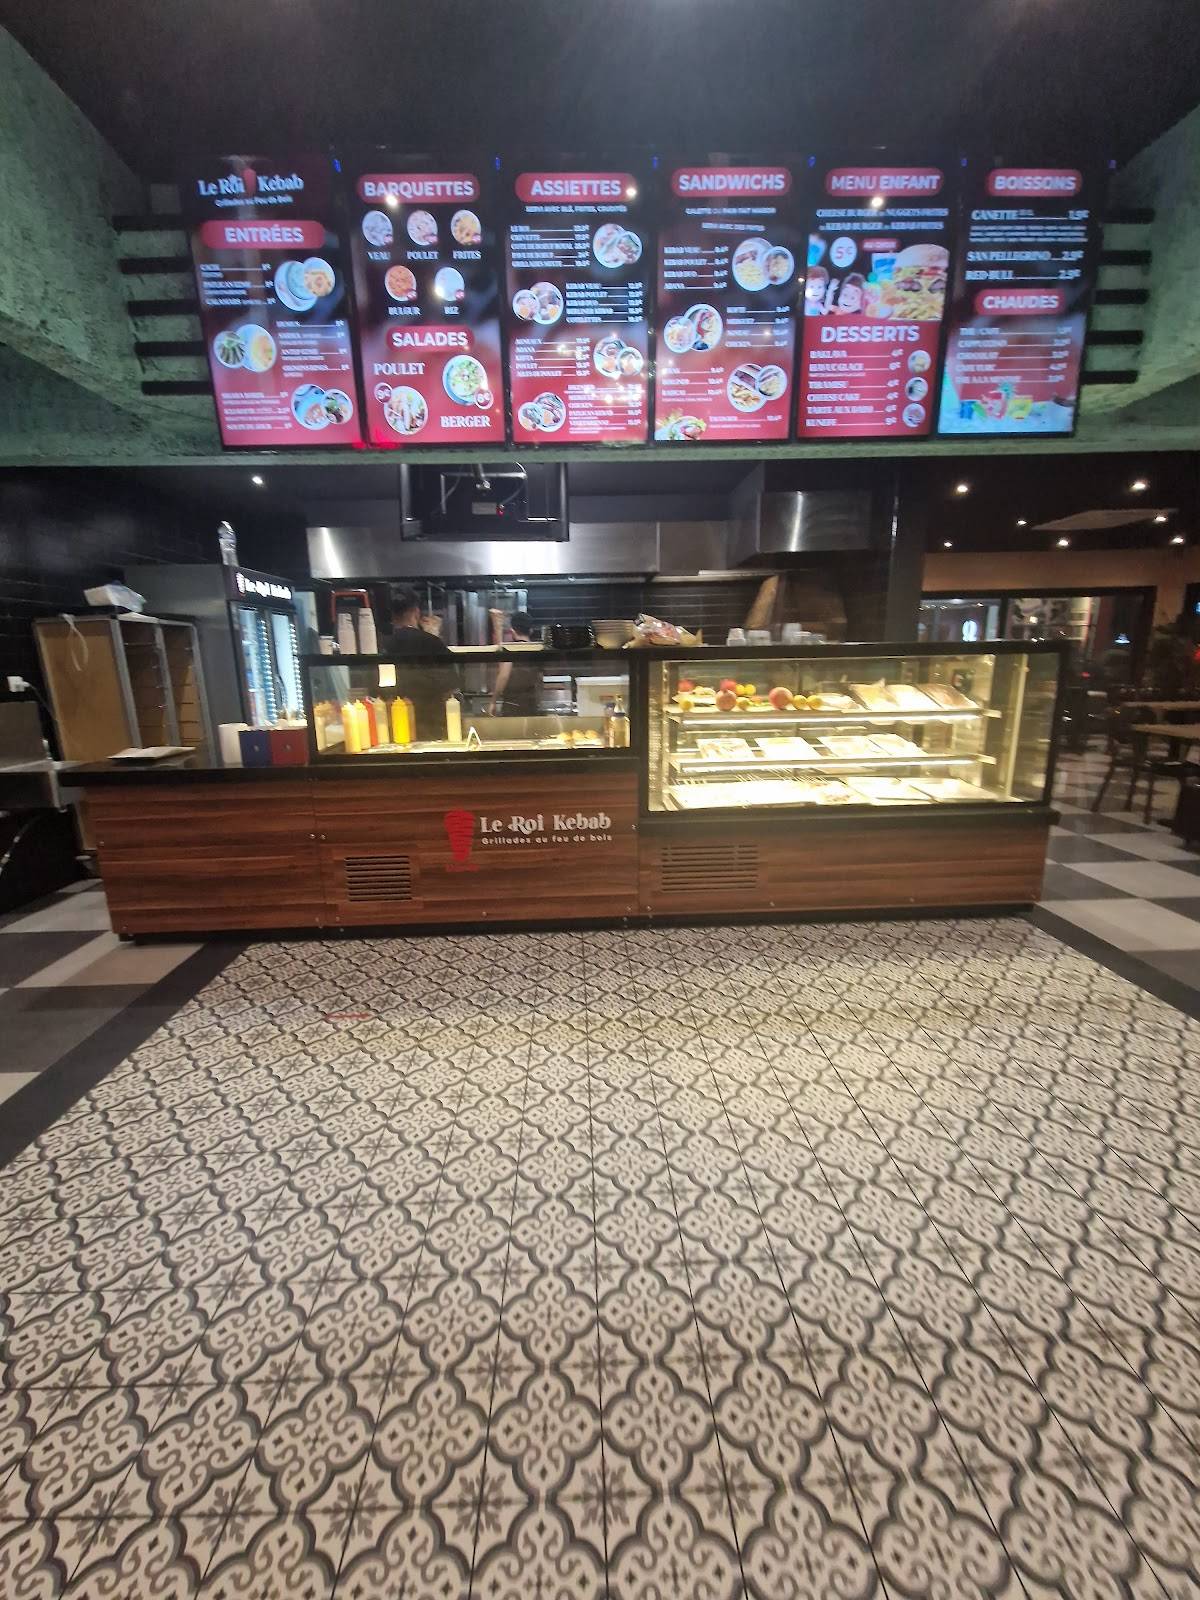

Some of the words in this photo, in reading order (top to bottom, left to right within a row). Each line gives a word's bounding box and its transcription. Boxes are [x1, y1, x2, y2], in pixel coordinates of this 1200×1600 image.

[198, 180, 219, 196] Le
[217, 174, 245, 194] Roi
[257, 173, 304, 191] Kebab
[363, 181, 475, 199] BARQUETTES
[530, 179, 622, 196] ASSIETTES
[678, 175, 786, 191] SANDWICHS
[831, 175, 877, 190] MENU
[879, 175, 940, 190] ENFANT
[994, 175, 1077, 190] BOISSONS
[224, 224, 305, 243] ENTRÉES
[406, 251, 439, 260] POULET
[452, 250, 482, 260] FRITES
[982, 296, 1059, 309] CHAUDES
[391, 331, 469, 348] SALADES
[821, 325, 920, 343] DESSERTS
[374, 362, 425, 376] POULET
[440, 414, 491, 428] BERGER
[255, 581, 271, 597] Roi
[480, 816, 503, 833] Le
[507, 814, 545, 835] Roi
[552, 812, 612, 831] Kebab
[481, 836, 531, 845] Grillades
[551, 835, 569, 843] feu
[573, 834, 586, 842] de
[589, 833, 612, 842] bois
